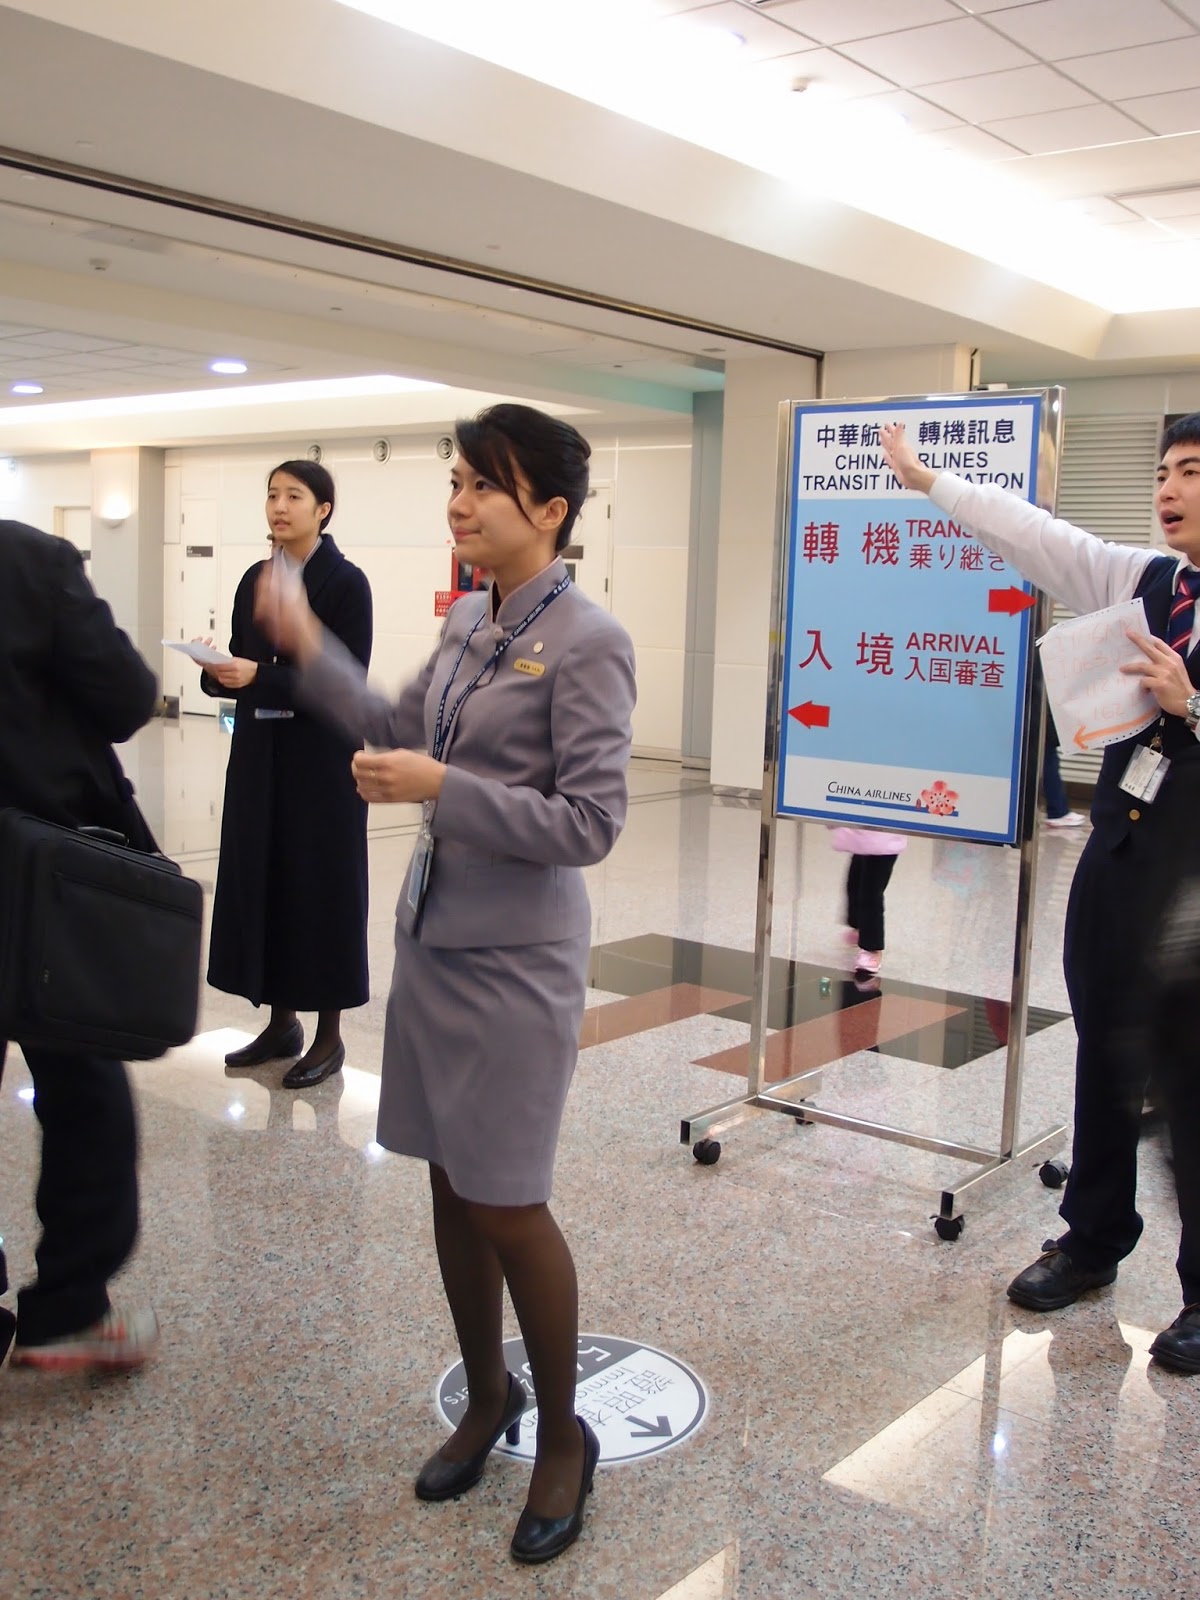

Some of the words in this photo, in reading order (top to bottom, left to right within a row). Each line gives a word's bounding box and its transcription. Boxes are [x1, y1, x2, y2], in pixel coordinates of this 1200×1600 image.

[817, 422, 905, 448] 中華航
[918, 419, 1016, 446] 轉機訊息
[835, 454, 892, 470] CHINA
[918, 451, 988, 469] RLINES
[803, 474, 880, 491] TRANSIT
[885, 472, 1024, 490] INATION
[906, 632, 1005, 655] ARRIVAL
[904, 656, 1005, 688] 入国審査
[827, 781, 861, 796] CHINA
[865, 788, 912, 802] AIRLINES
